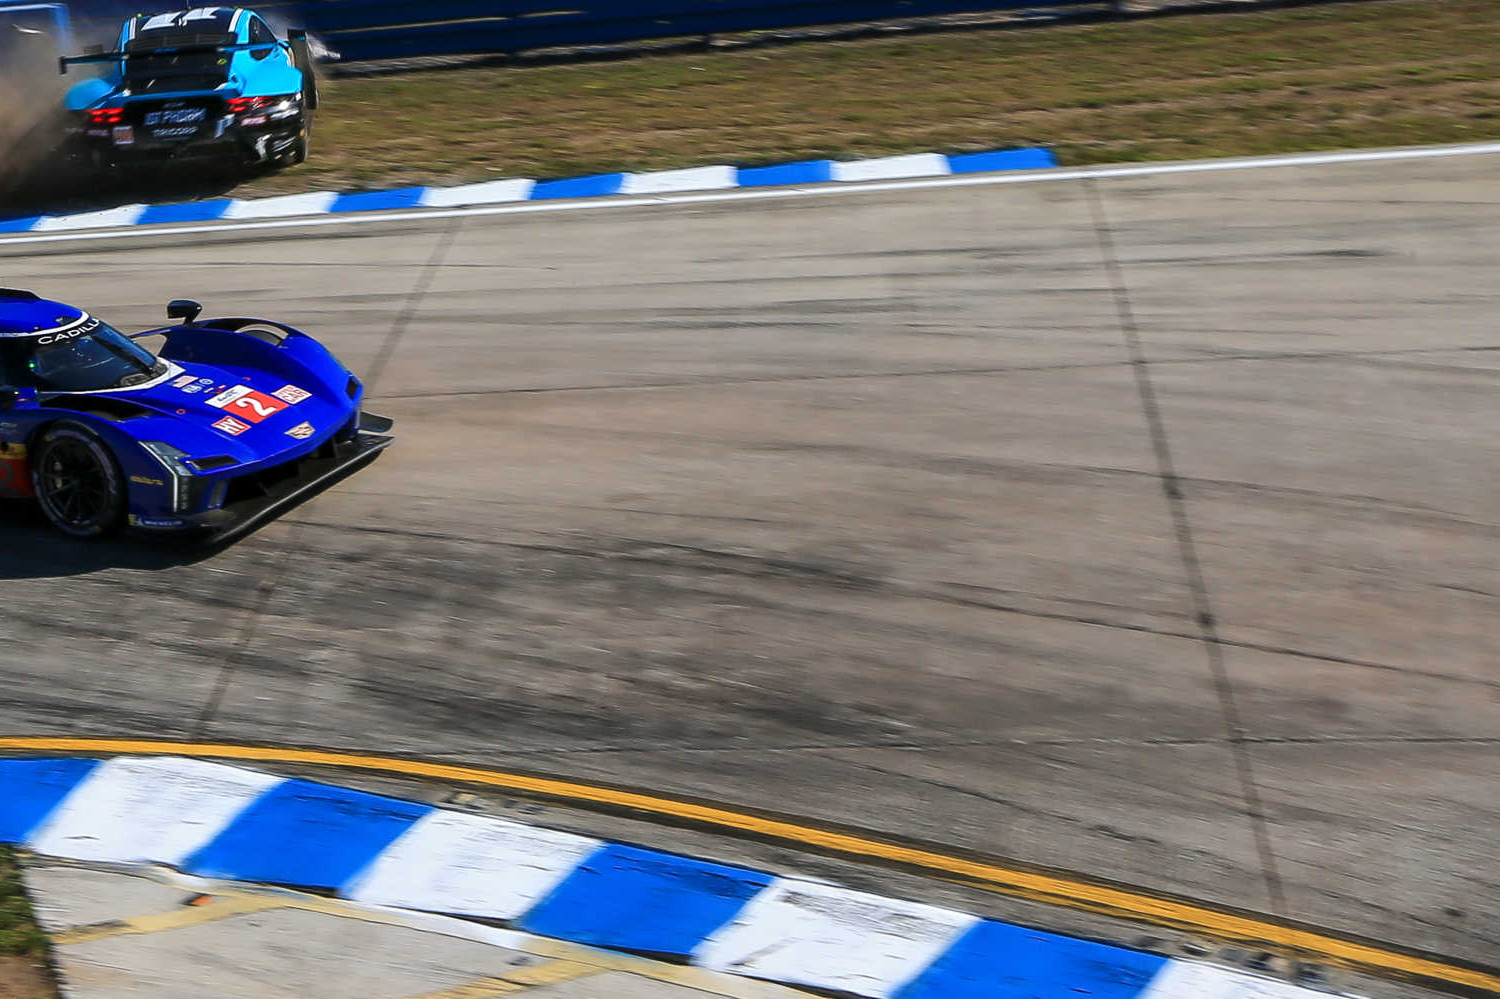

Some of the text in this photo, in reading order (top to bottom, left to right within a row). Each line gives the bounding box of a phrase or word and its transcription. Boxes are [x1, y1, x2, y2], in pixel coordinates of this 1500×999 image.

[37, 317, 100, 345] CADILL
[236, 397, 277, 416] 2
[214, 417, 245, 435] HY
